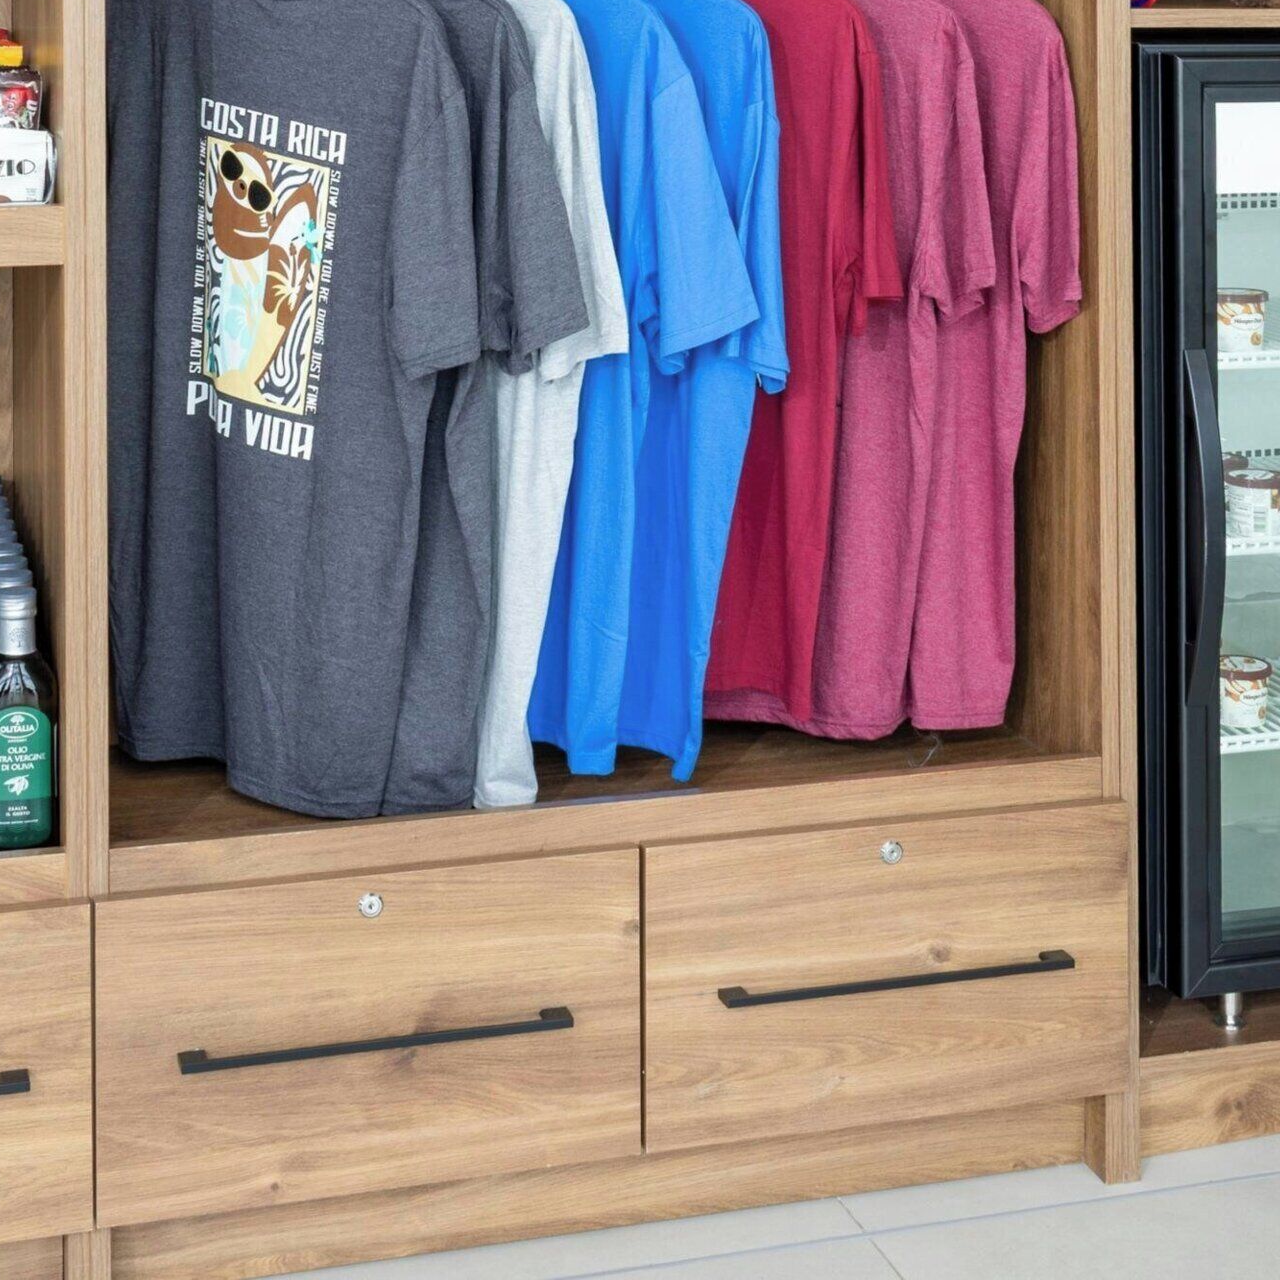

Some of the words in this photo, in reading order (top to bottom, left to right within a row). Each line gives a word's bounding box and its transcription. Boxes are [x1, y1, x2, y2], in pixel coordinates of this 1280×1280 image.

[201, 97, 279, 148] COSTA
[287, 120, 347, 165] RICA
[329, 169, 341, 208] SLOW
[324, 213, 337, 251] DOWN.
[190, 338, 202, 374] SLOW
[197, 204, 206, 240] DOING
[313, 308, 327, 345] DOING
[310, 350, 323, 381] JUST
[245, 409, 314, 461] VIDA
[0, 725, 34, 734] OLITALIA
[8, 746, 27, 754] OLIO
[11, 762, 34, 771] OLIVA
[15, 753, 46, 762] VERGINE
